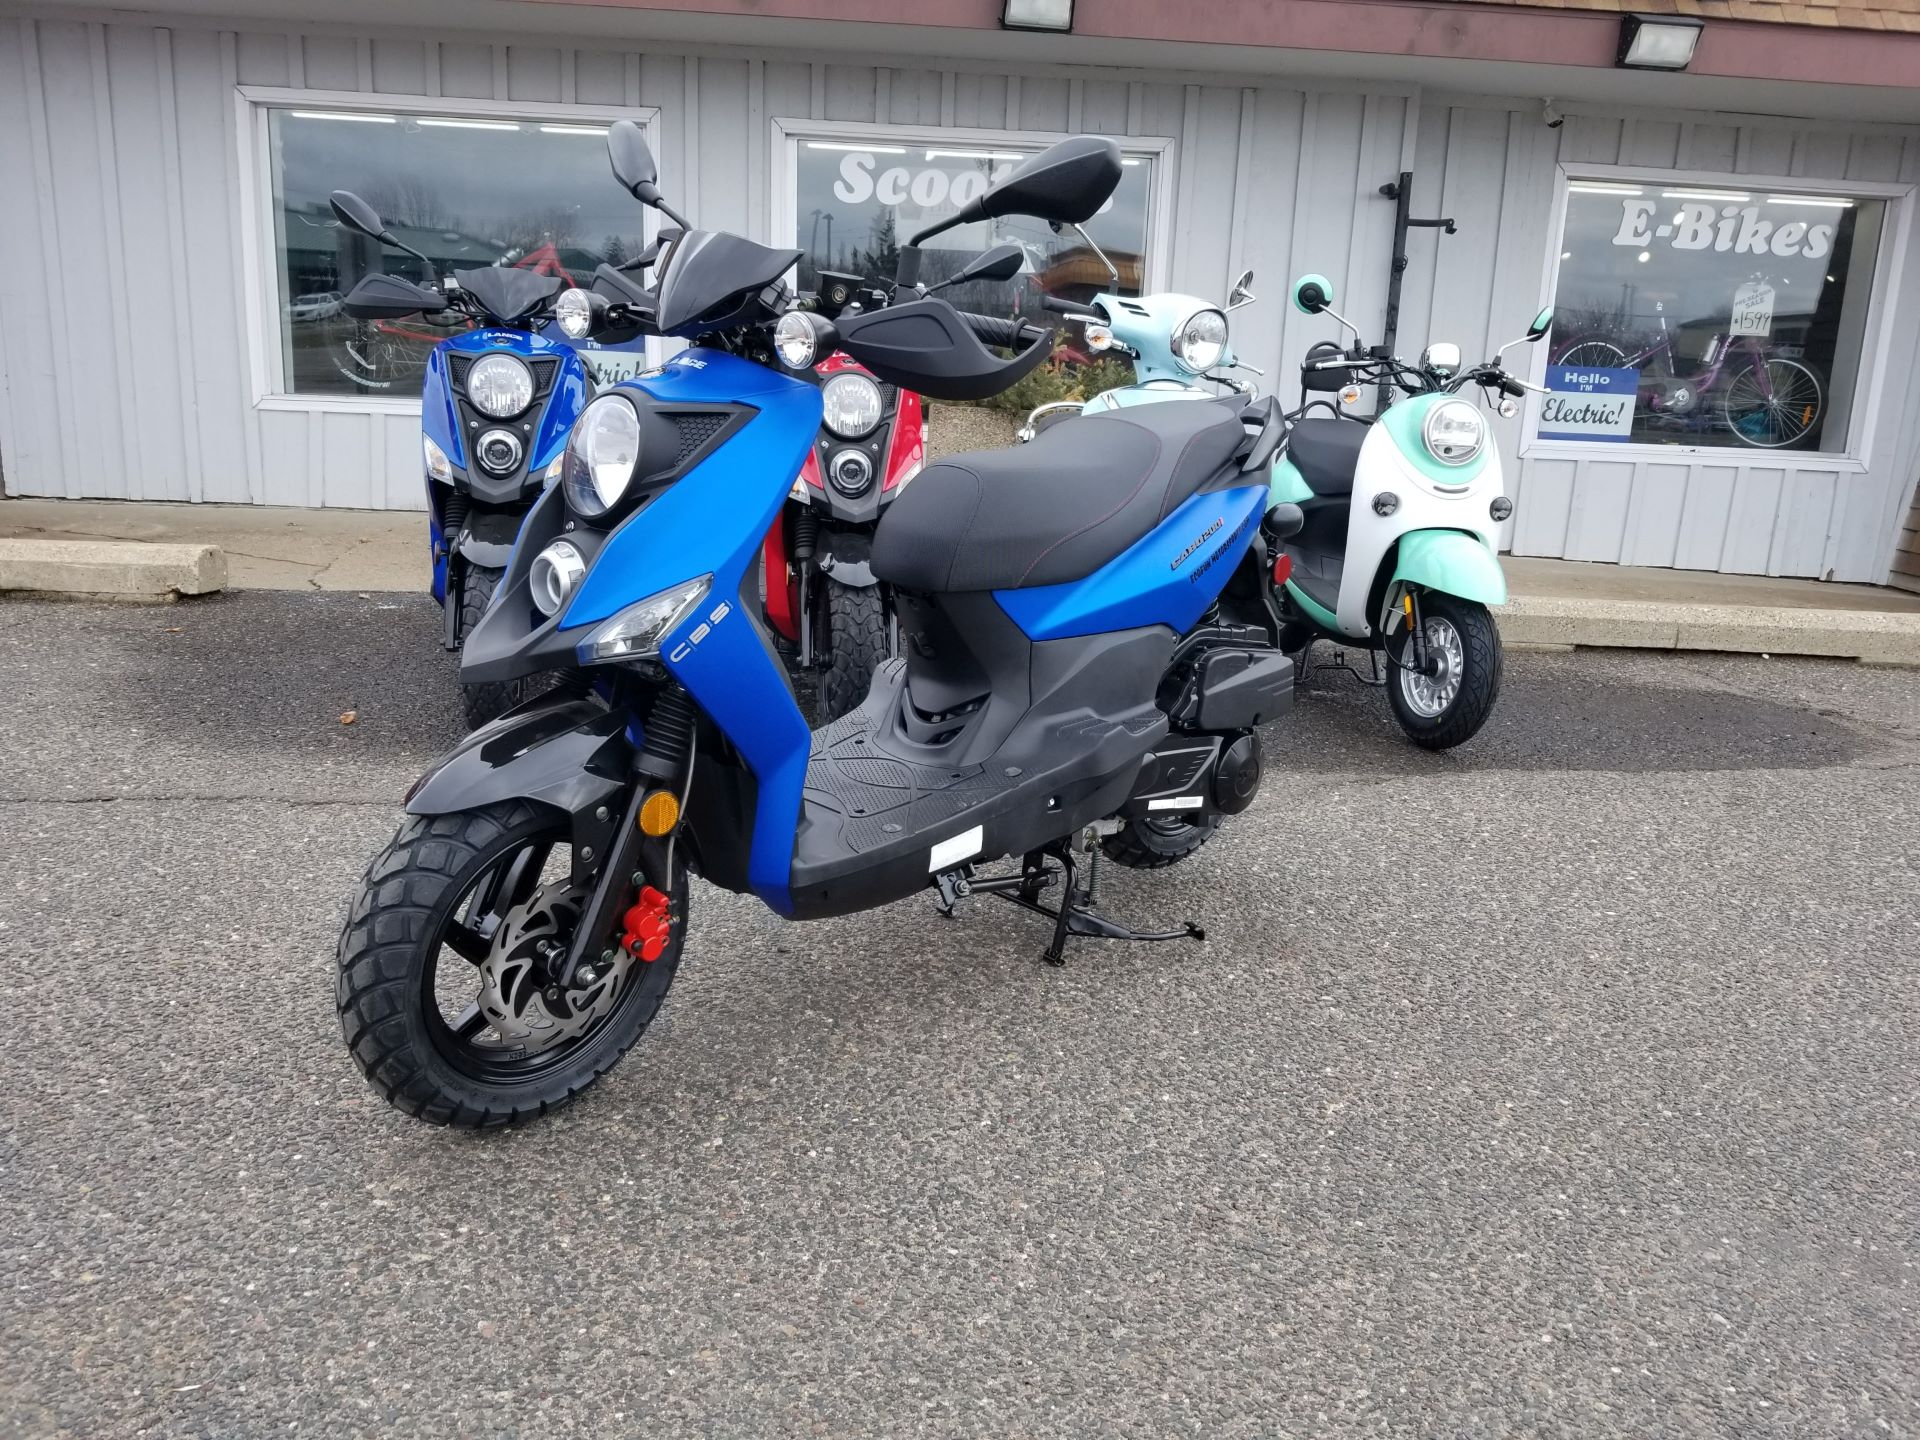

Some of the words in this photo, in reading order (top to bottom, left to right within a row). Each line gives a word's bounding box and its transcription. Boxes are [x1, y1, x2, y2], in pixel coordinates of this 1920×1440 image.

[1612, 199, 1833, 259] E-Bikes
[487, 332, 524, 341] LANCE
[665, 357, 708, 370] ANCE
[1564, 371, 1611, 385] Hello
[1579, 384, 1593, 392] I'M
[1541, 397, 1625, 426] Electric!
[670, 600, 732, 662] CBS
